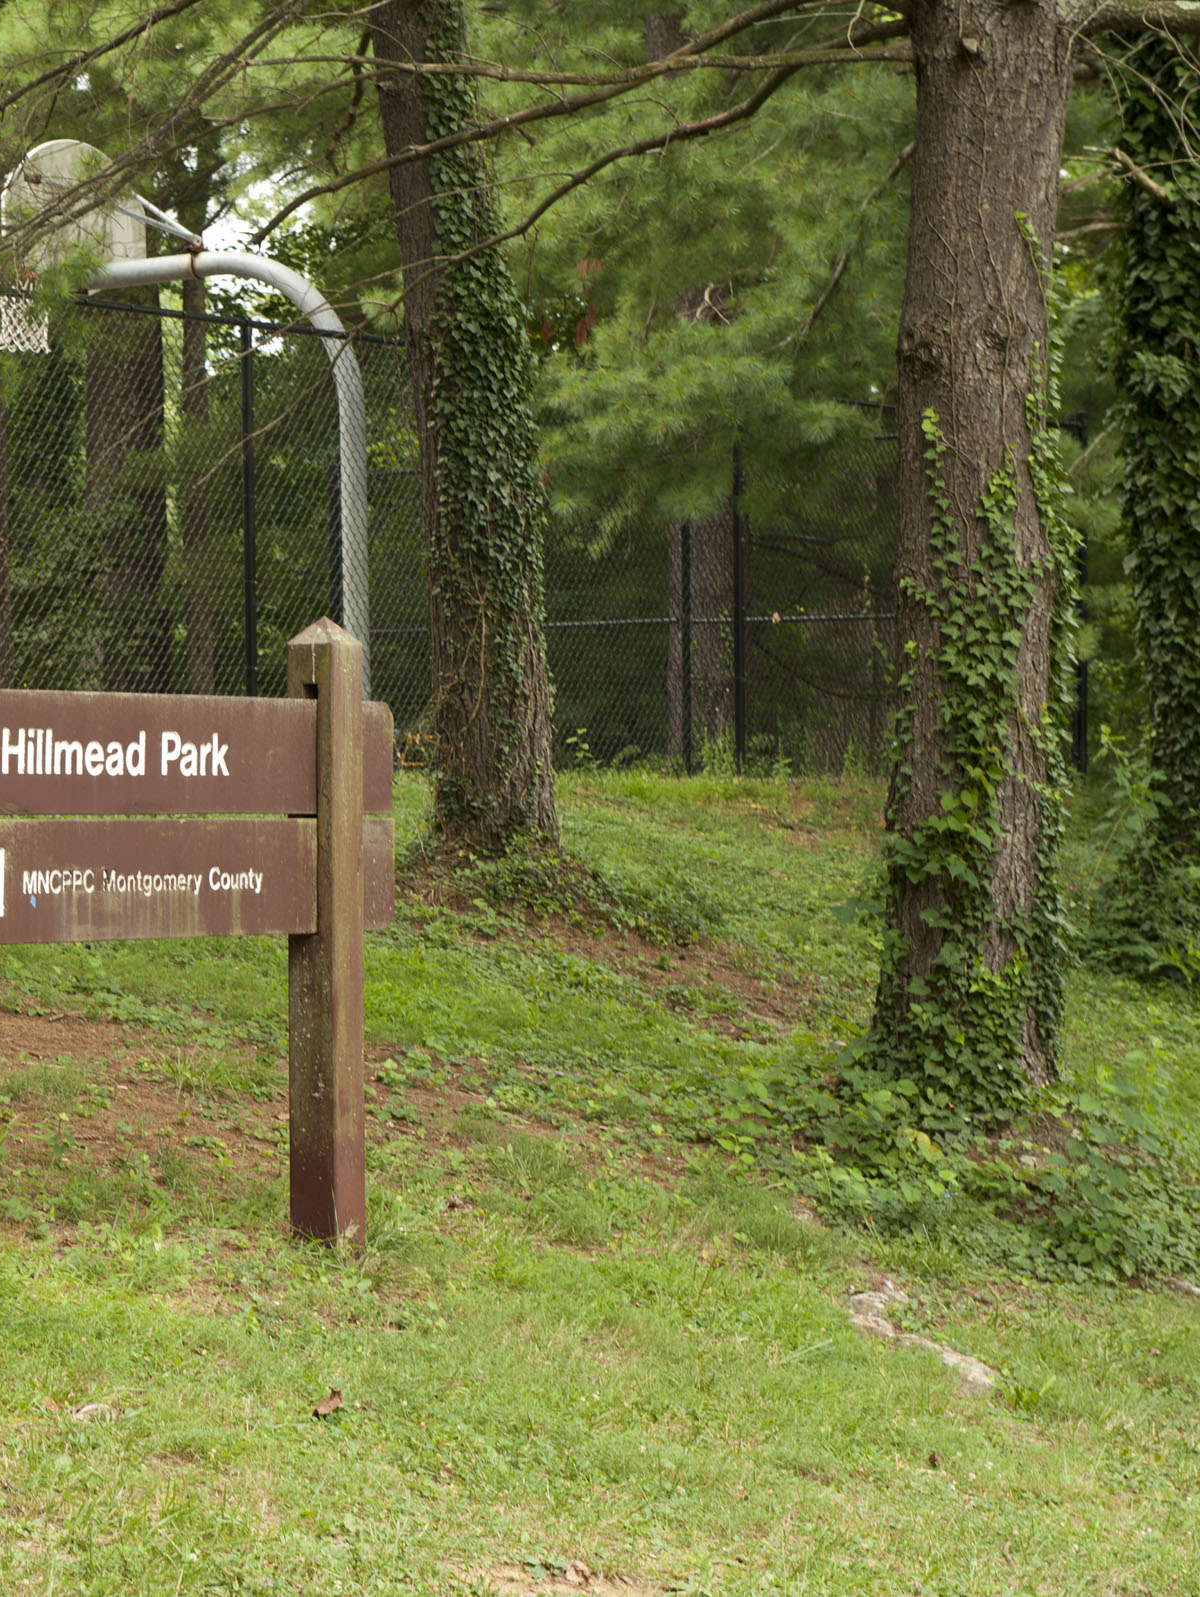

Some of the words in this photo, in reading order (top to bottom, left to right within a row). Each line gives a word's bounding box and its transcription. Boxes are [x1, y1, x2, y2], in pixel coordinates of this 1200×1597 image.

[1, 727, 147, 777] Hillmead
[160, 731, 230, 777] Park
[22, 869, 95, 895] MNCPPC
[103, 869, 203, 897] Montgomery
[208, 866, 264, 895] County
